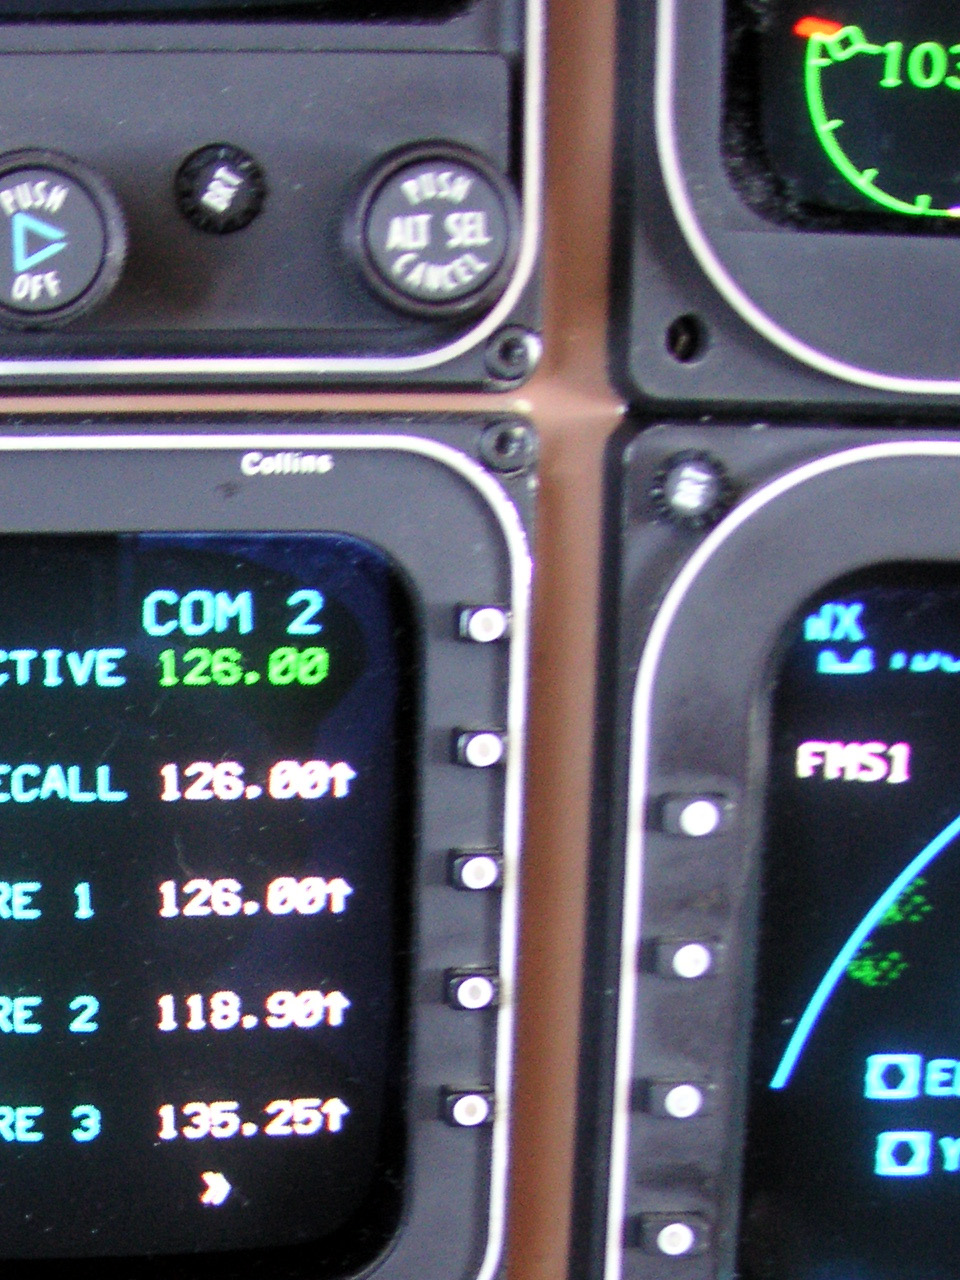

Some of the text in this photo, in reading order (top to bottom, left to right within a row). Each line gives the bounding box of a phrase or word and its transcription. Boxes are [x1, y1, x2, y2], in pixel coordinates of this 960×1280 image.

[400, 171, 474, 205] PUSH
[385, 212, 494, 249] ALT SEL
[11, 270, 61, 301] OFF
[390, 253, 489, 293] CANCEL
[240, 451, 335, 477] Collins
[142, 590, 324, 636] COM 2
[158, 646, 330, 686] 126.00
[796, 742, 911, 784] FMS1
[73, 882, 94, 919] 1
[69, 995, 99, 1032] 2
[71, 1104, 101, 1141] 3
